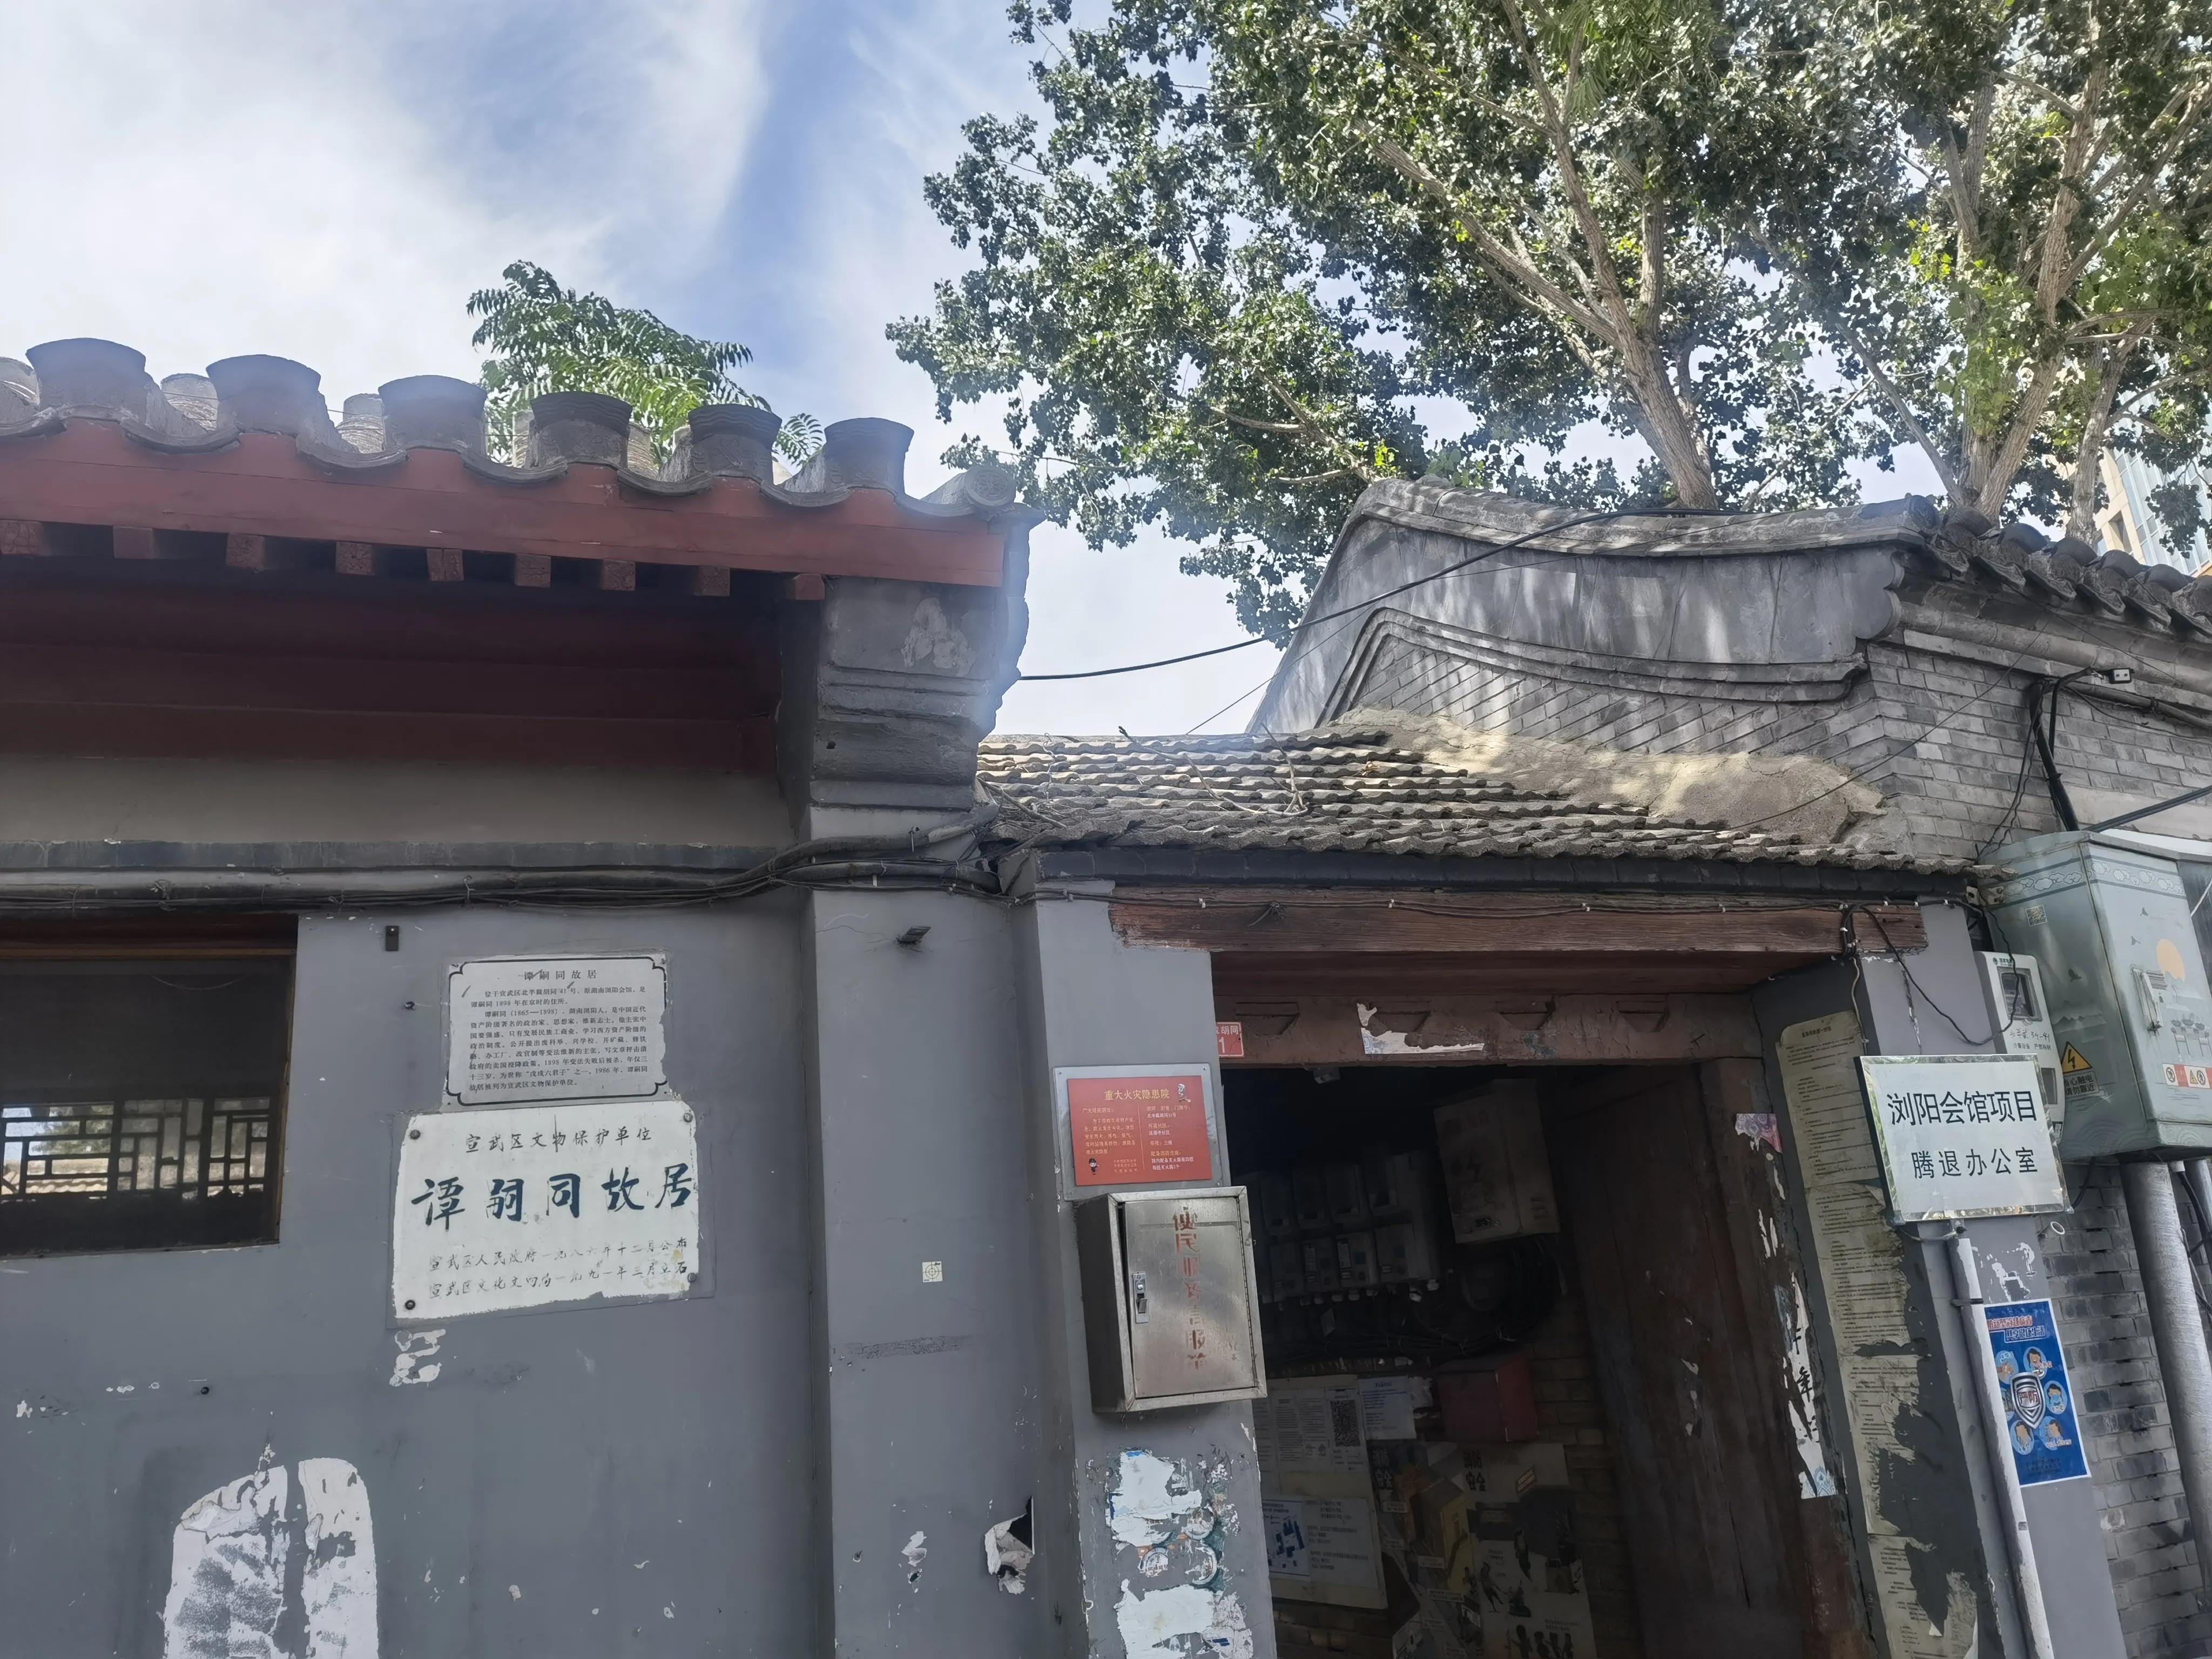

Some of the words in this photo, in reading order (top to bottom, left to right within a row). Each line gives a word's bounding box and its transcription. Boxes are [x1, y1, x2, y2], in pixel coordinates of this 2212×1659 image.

[524, 970, 597, 981] 谭嗣同故居
[1216, 1026, 1238, 1035] 胡同
[2064, 1075, 2094, 1087] 当心触电
[1104, 1089, 1170, 1101] 重大火灾隐患院
[1887, 1090, 2038, 1126] 浏阳会馆项目
[466, 1127, 652, 1153] 宣武区文物保护单位
[1911, 1147, 2038, 1179] 腾退办公室
[412, 1163, 692, 1231] 谭嗣同故居
[2018, 1390, 2038, 1404] 严防
